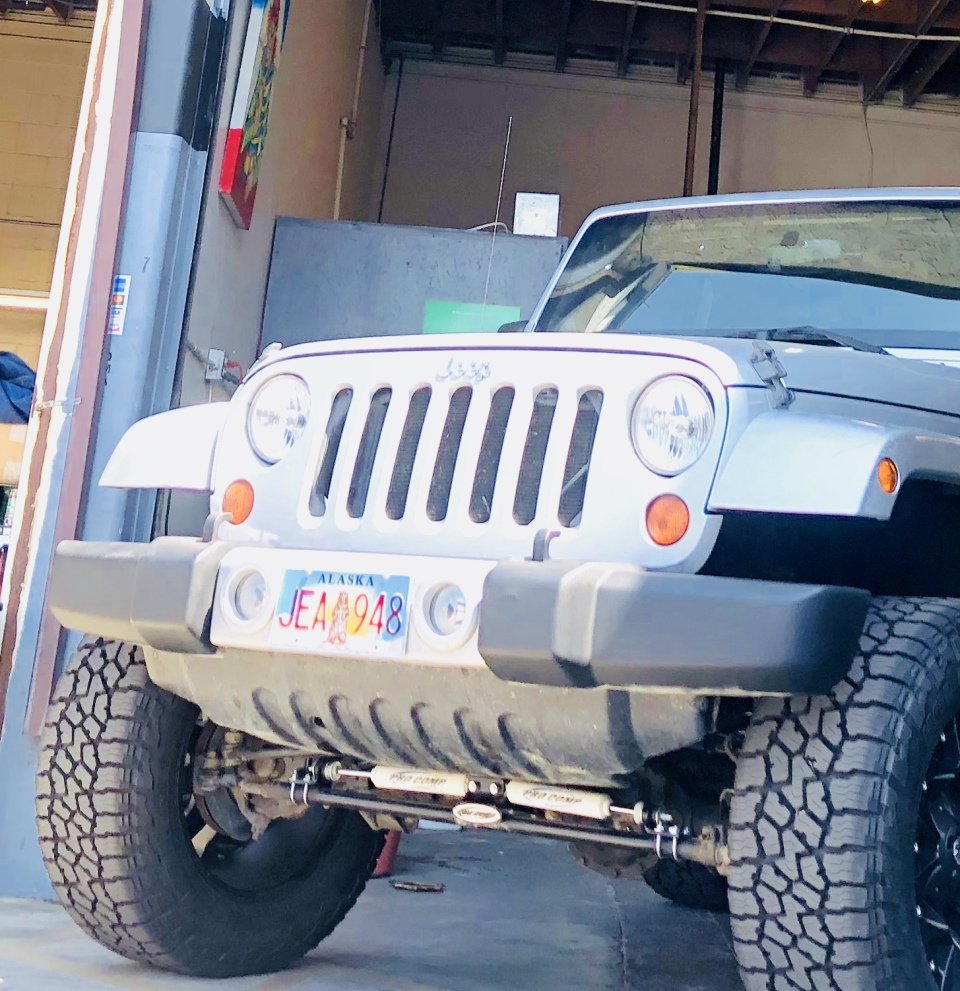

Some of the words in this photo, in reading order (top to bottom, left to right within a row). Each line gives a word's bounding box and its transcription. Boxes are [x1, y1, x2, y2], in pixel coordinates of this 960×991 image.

[142, 256, 151, 273] 7
[317, 573, 375, 587] ALASKA
[278, 588, 328, 632] JEA
[354, 593, 404, 636] 948
